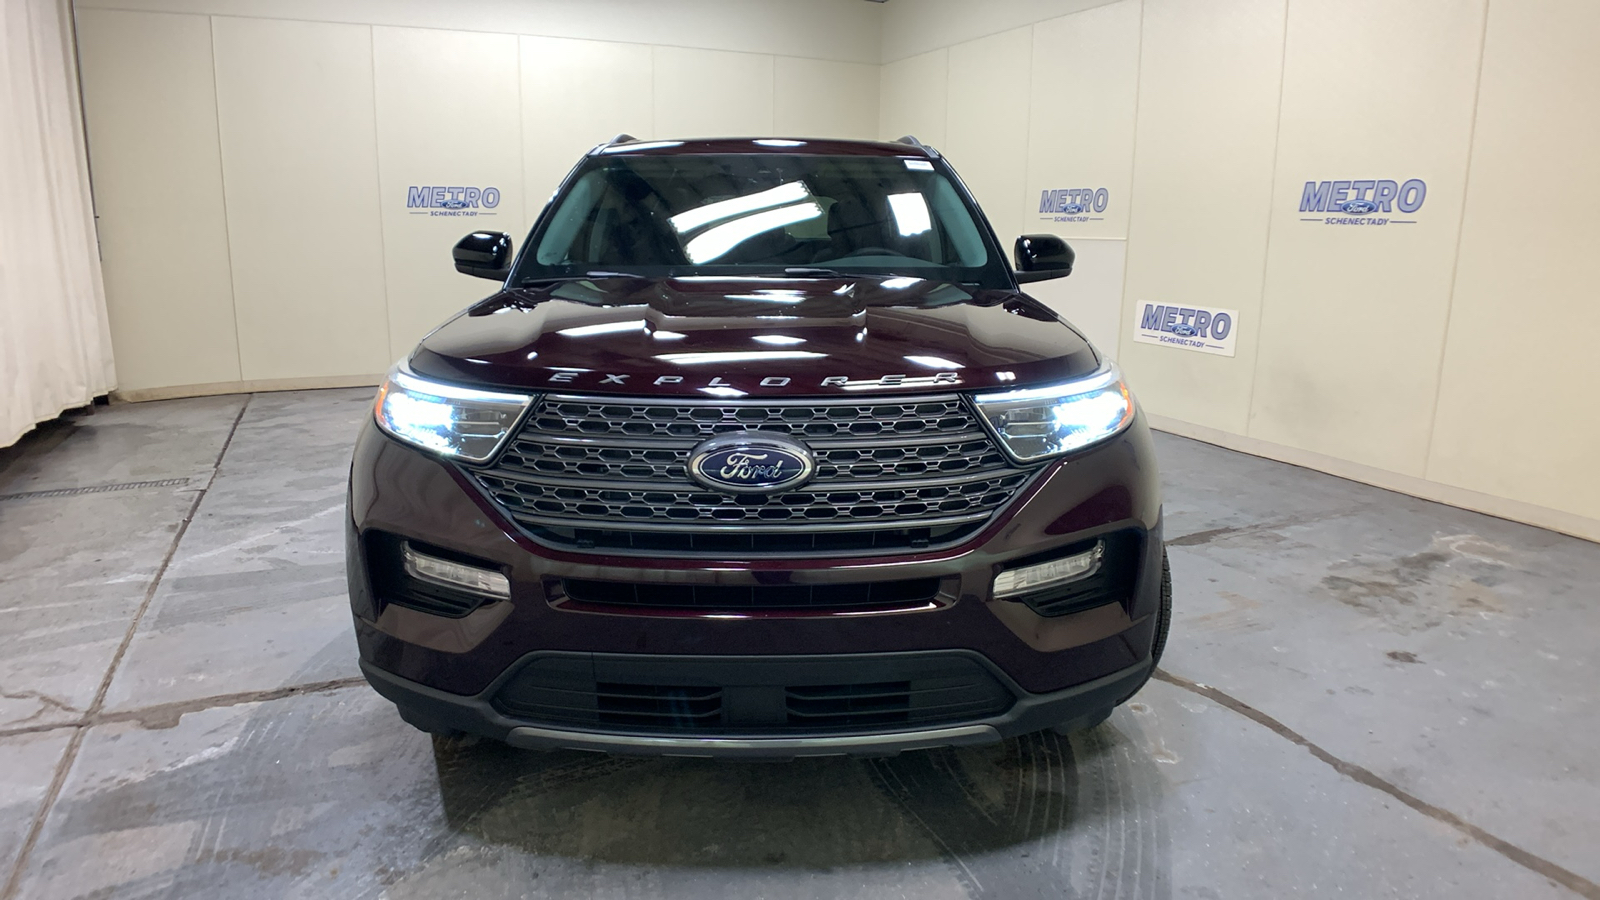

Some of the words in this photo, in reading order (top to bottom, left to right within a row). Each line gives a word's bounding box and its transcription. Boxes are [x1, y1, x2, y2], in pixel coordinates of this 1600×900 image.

[406, 186, 500, 209] METRO
[1039, 187, 1109, 213] METRO
[1298, 178, 1427, 213] METRO
[1325, 217, 1389, 225] SCHENECTADY
[1140, 304, 1232, 341] METRO
[1159, 335, 1205, 348] SCHENECTADY
[547, 372, 961, 388] EXPLORER
[720, 452, 784, 479] Ford
